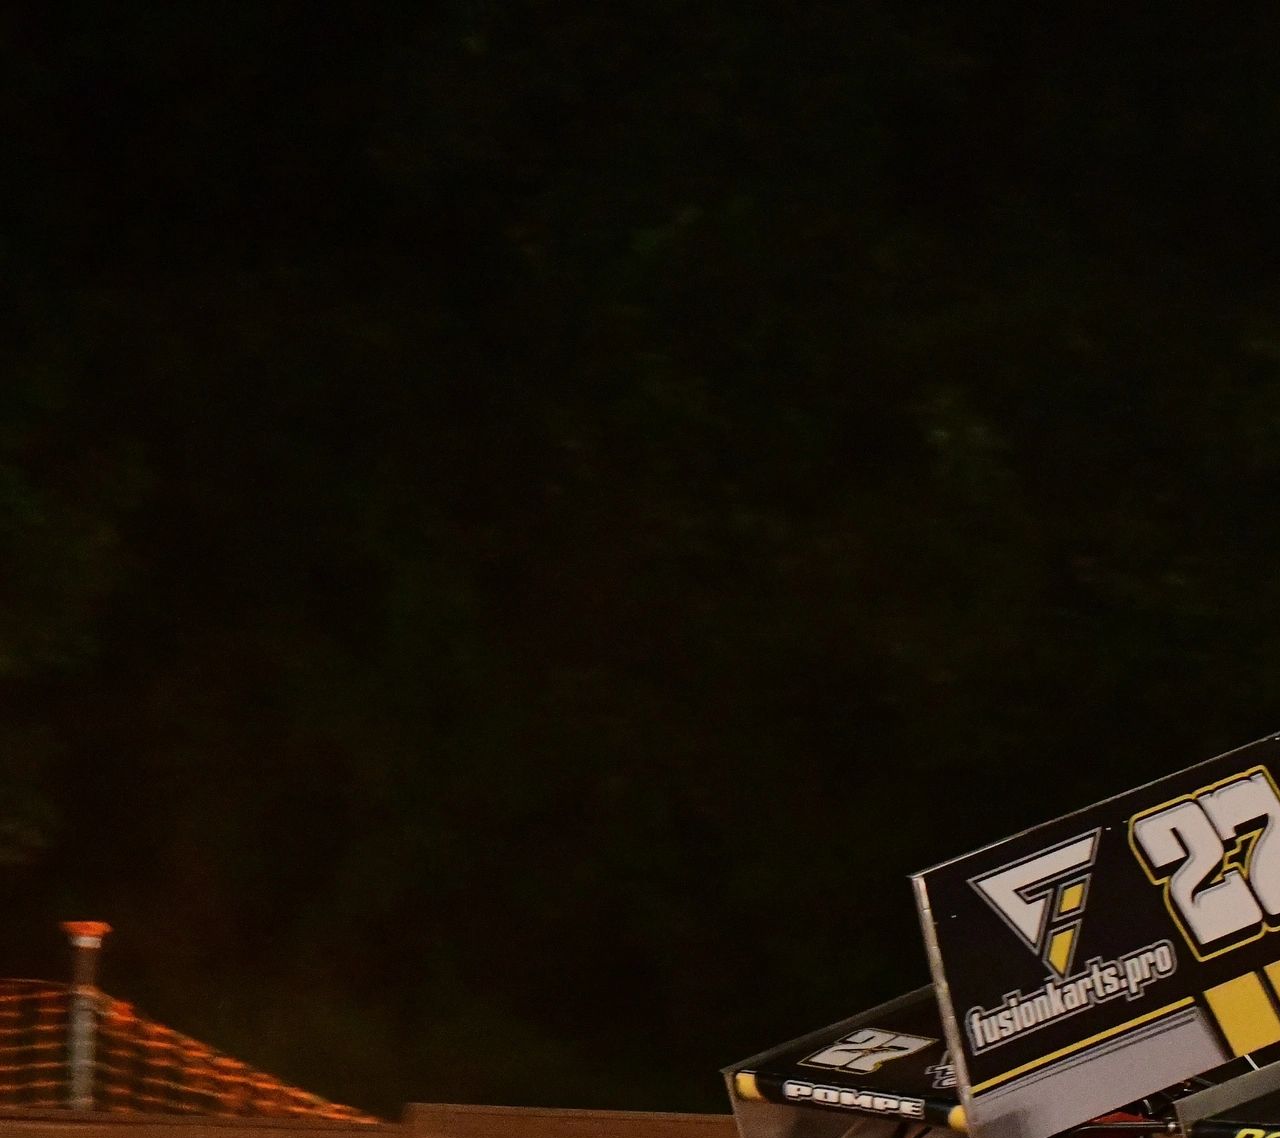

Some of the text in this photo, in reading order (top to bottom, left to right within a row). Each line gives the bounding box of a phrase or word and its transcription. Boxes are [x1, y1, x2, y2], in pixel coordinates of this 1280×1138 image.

[966, 942, 1174, 1051] fusionkarts.pro
[798, 1028, 939, 1074] 27
[784, 1080, 925, 1119] POMPE
